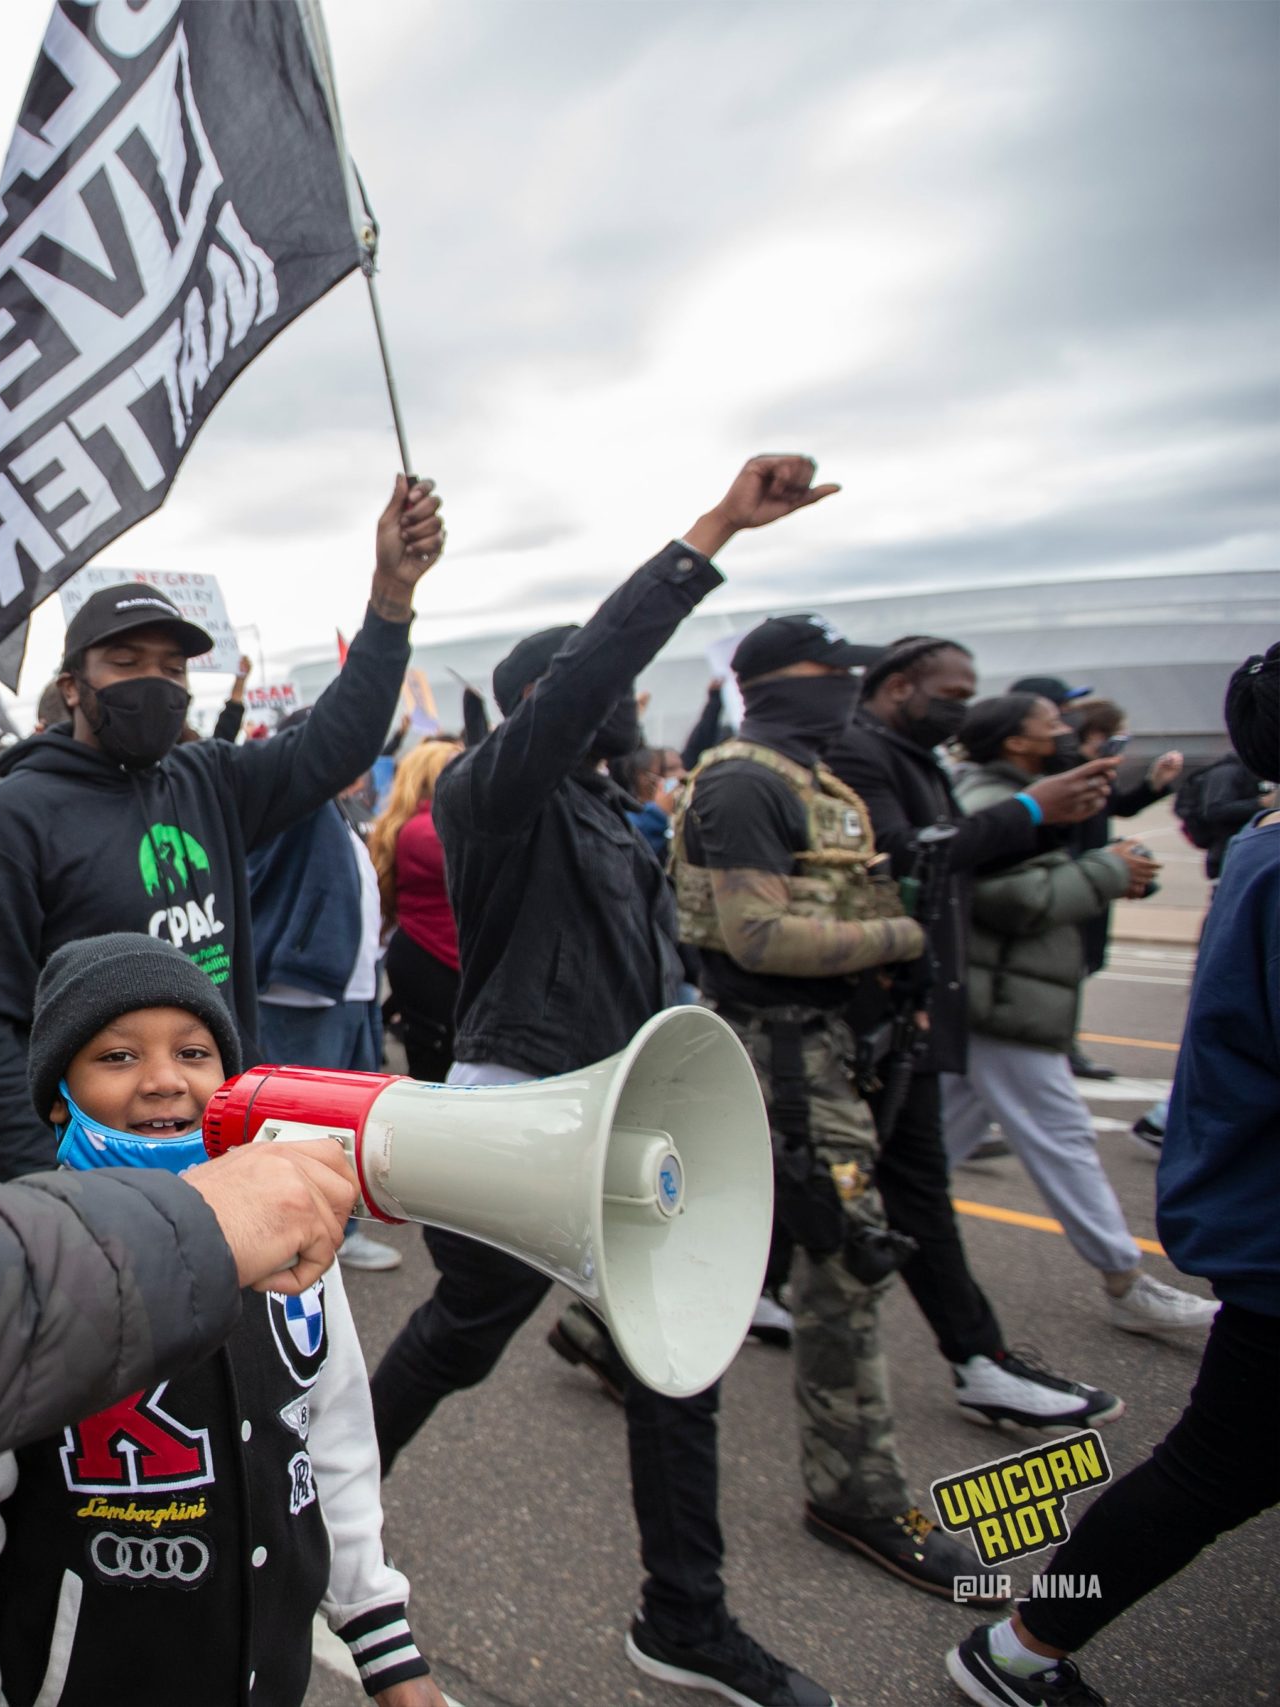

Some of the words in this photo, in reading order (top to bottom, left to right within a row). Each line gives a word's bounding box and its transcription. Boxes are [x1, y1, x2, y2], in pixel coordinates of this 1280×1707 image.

[134, 571, 205, 586] NEGRO
[148, 893, 225, 948] CPAC
[77, 1497, 207, 1529] Lamborghini
